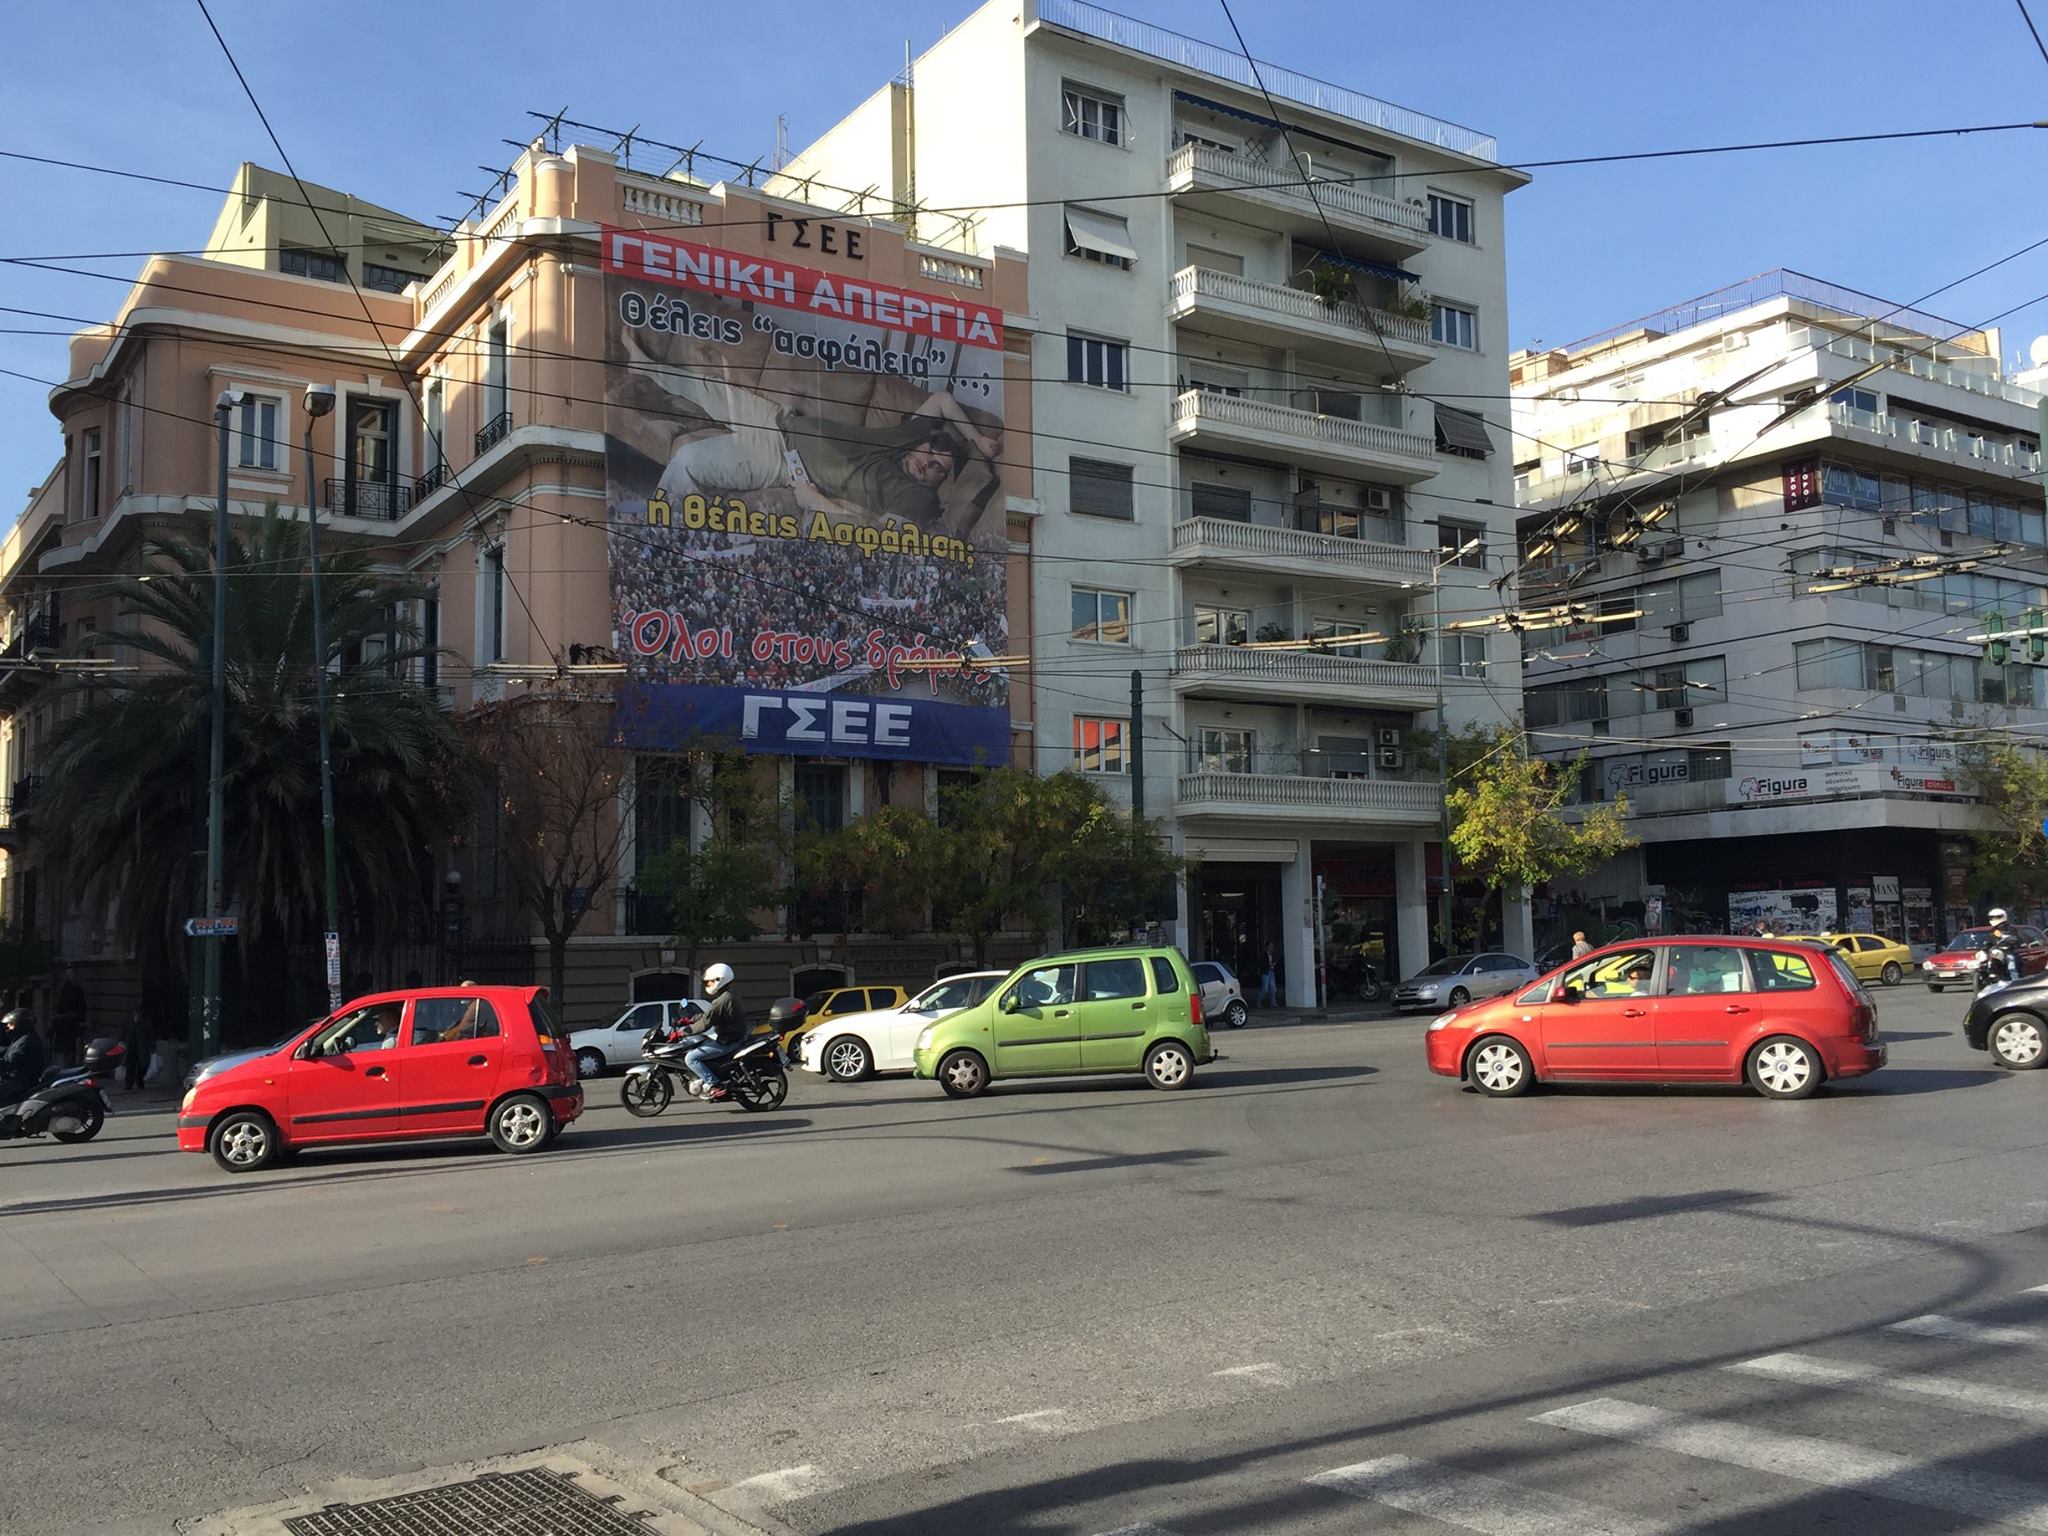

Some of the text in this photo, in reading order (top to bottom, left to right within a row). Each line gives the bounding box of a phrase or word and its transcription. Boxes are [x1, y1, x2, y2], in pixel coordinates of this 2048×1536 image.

[767, 211, 864, 260] ΓΣΕΕ
[612, 234, 999, 345] ΓΕΝΙΚΗ ΑΠΕΡΓΙΑ
[648, 488, 975, 570] ή θέλεις Ασφάλιση;
[623, 609, 733, 663] Όλοι
[752, 631, 852, 669] στους
[743, 694, 912, 747] ΓΣΕΕ
[1629, 764, 1688, 784] Figura
[1757, 778, 1808, 796] Figura
[1897, 775, 1923, 789] Figura
